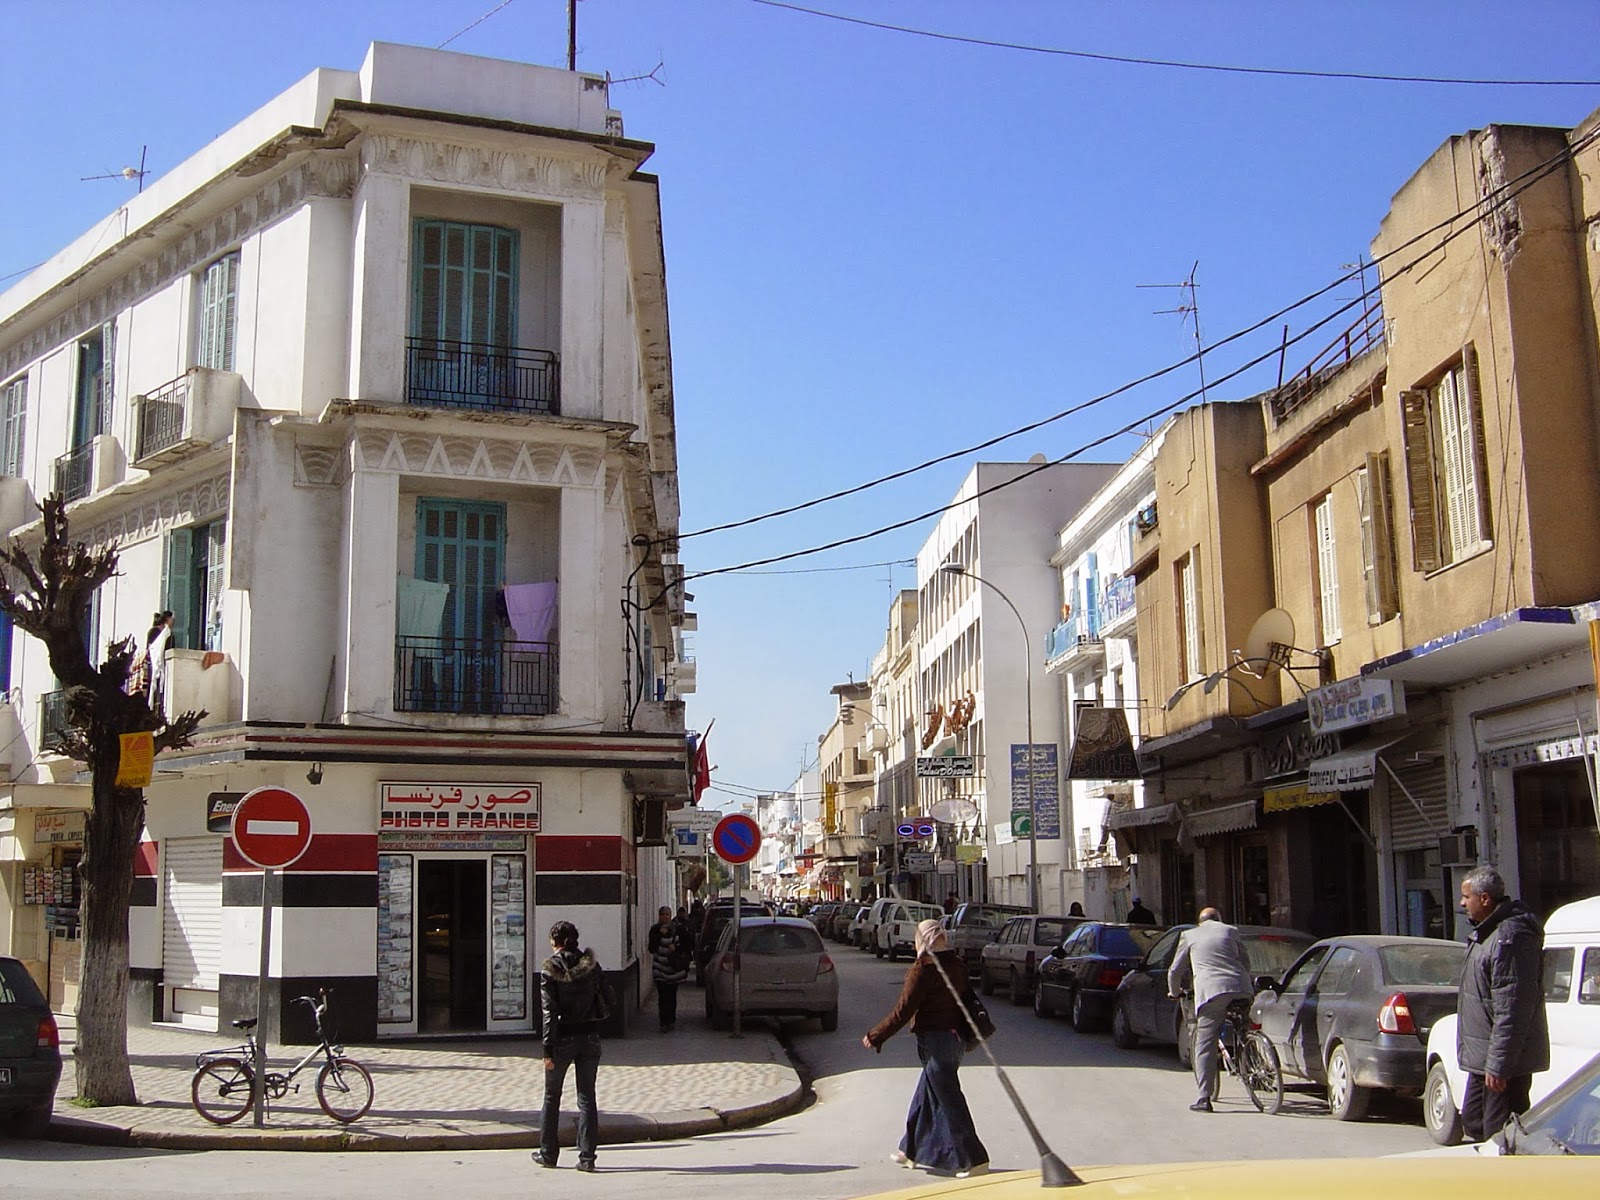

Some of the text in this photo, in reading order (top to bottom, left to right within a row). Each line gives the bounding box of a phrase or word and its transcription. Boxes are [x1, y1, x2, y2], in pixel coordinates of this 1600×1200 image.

[119, 775, 147, 786] Kodak
[212, 800, 238, 812] Ener
[387, 786, 532, 811] صور فرنسا
[381, 811, 539, 829] PHOTO FRANCE
